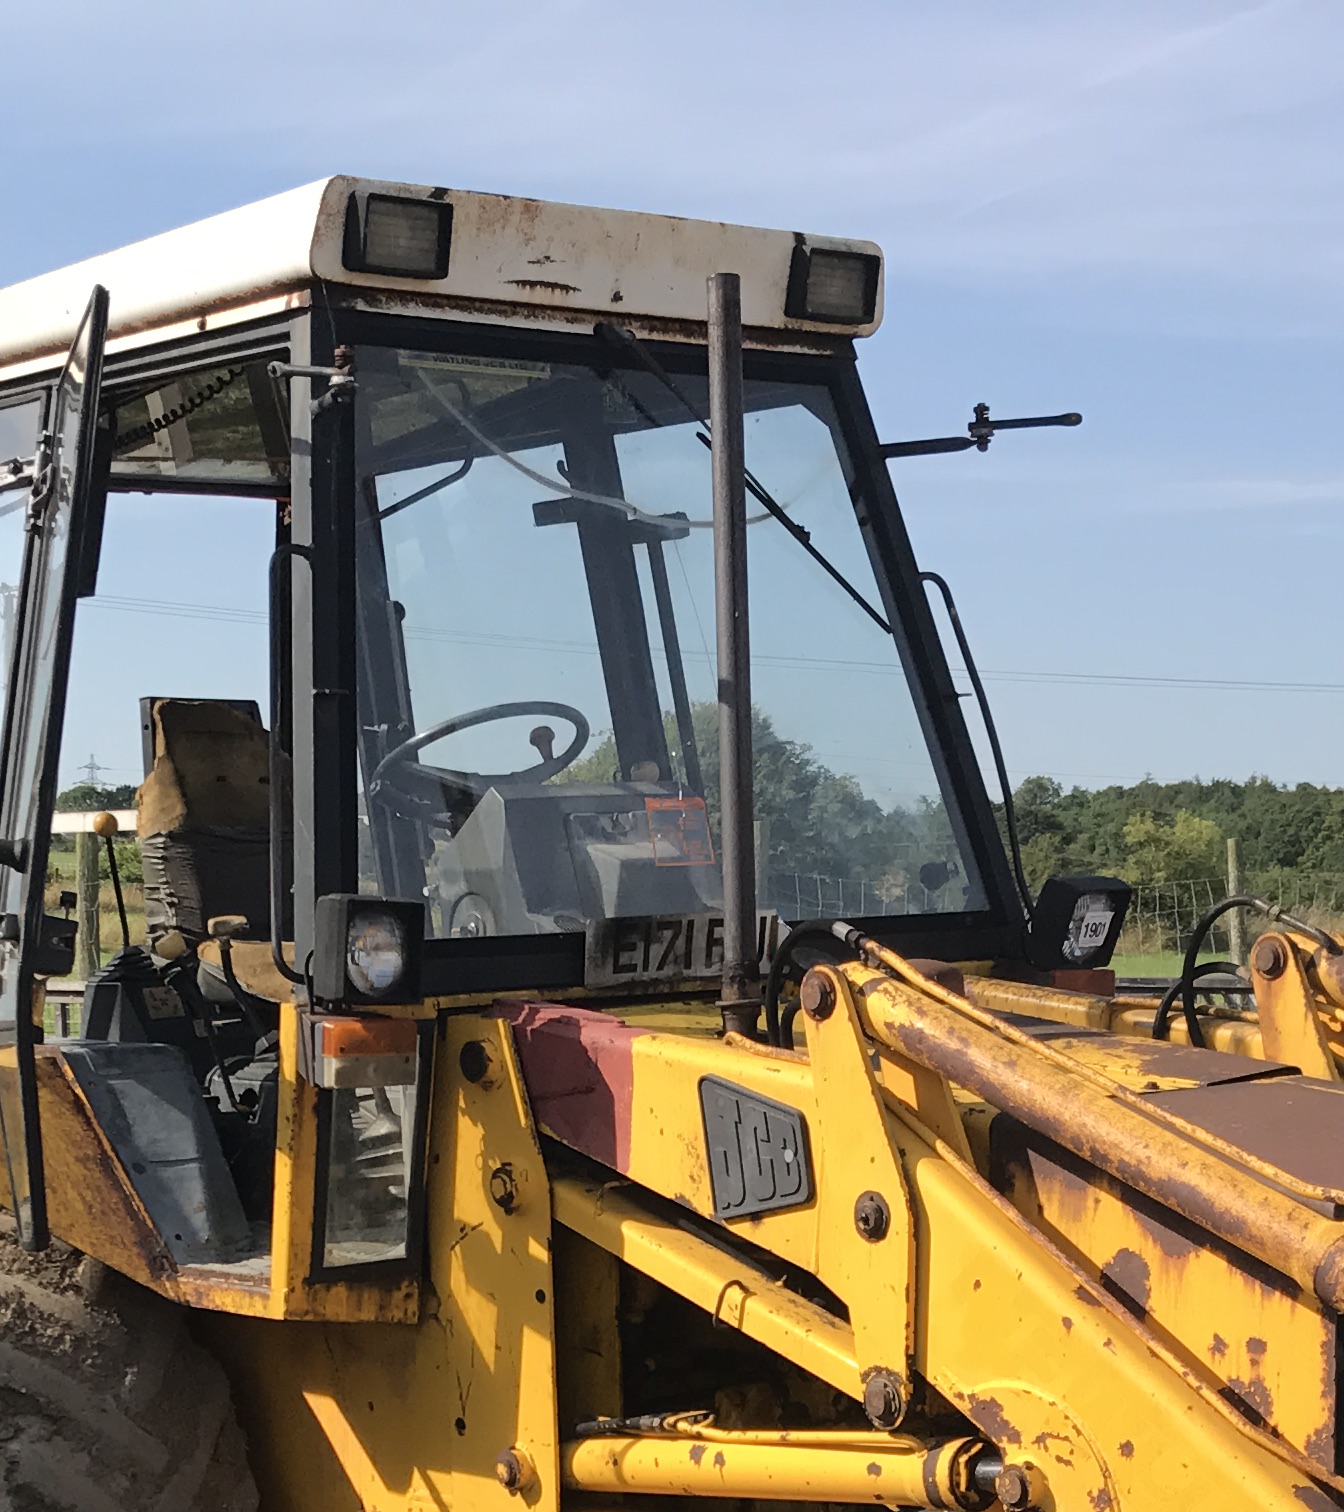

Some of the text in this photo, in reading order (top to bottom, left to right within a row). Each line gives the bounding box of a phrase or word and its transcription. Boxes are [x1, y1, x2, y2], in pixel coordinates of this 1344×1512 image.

[611, 919, 695, 974] E171
[1083, 921, 1107, 939] 1901
[713, 1089, 803, 1211] JCB
